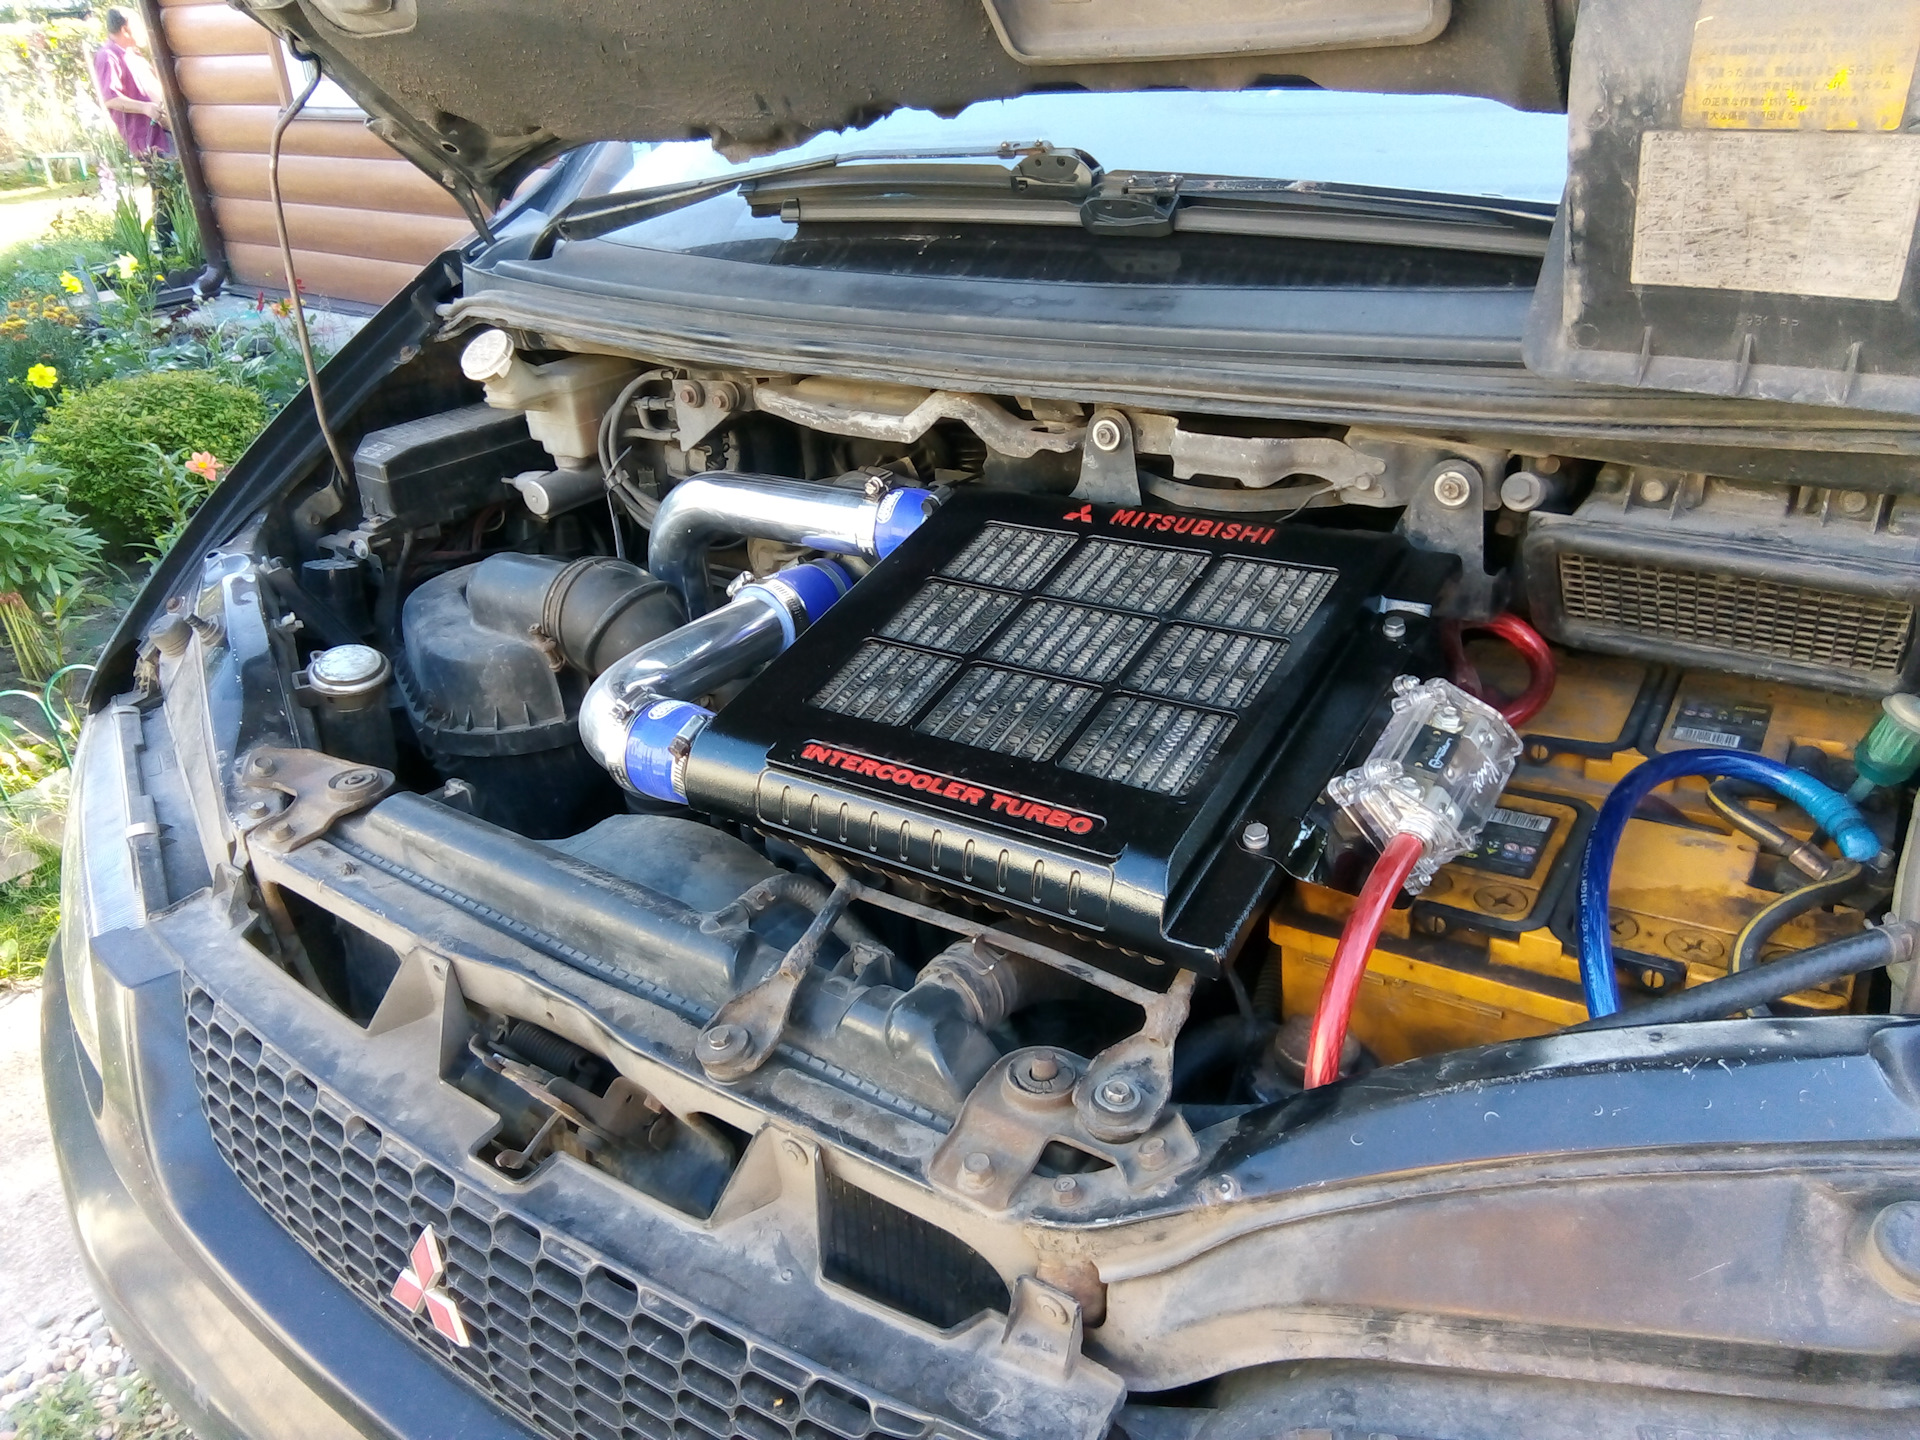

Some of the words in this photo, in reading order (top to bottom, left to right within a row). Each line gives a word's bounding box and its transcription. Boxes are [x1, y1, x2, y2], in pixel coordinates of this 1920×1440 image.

[1109, 509, 1275, 544] MITSUBISHI
[800, 744, 986, 806] INTERCOOLER
[989, 793, 1095, 834] TURBO
[1580, 879, 1588, 906] HIGH
